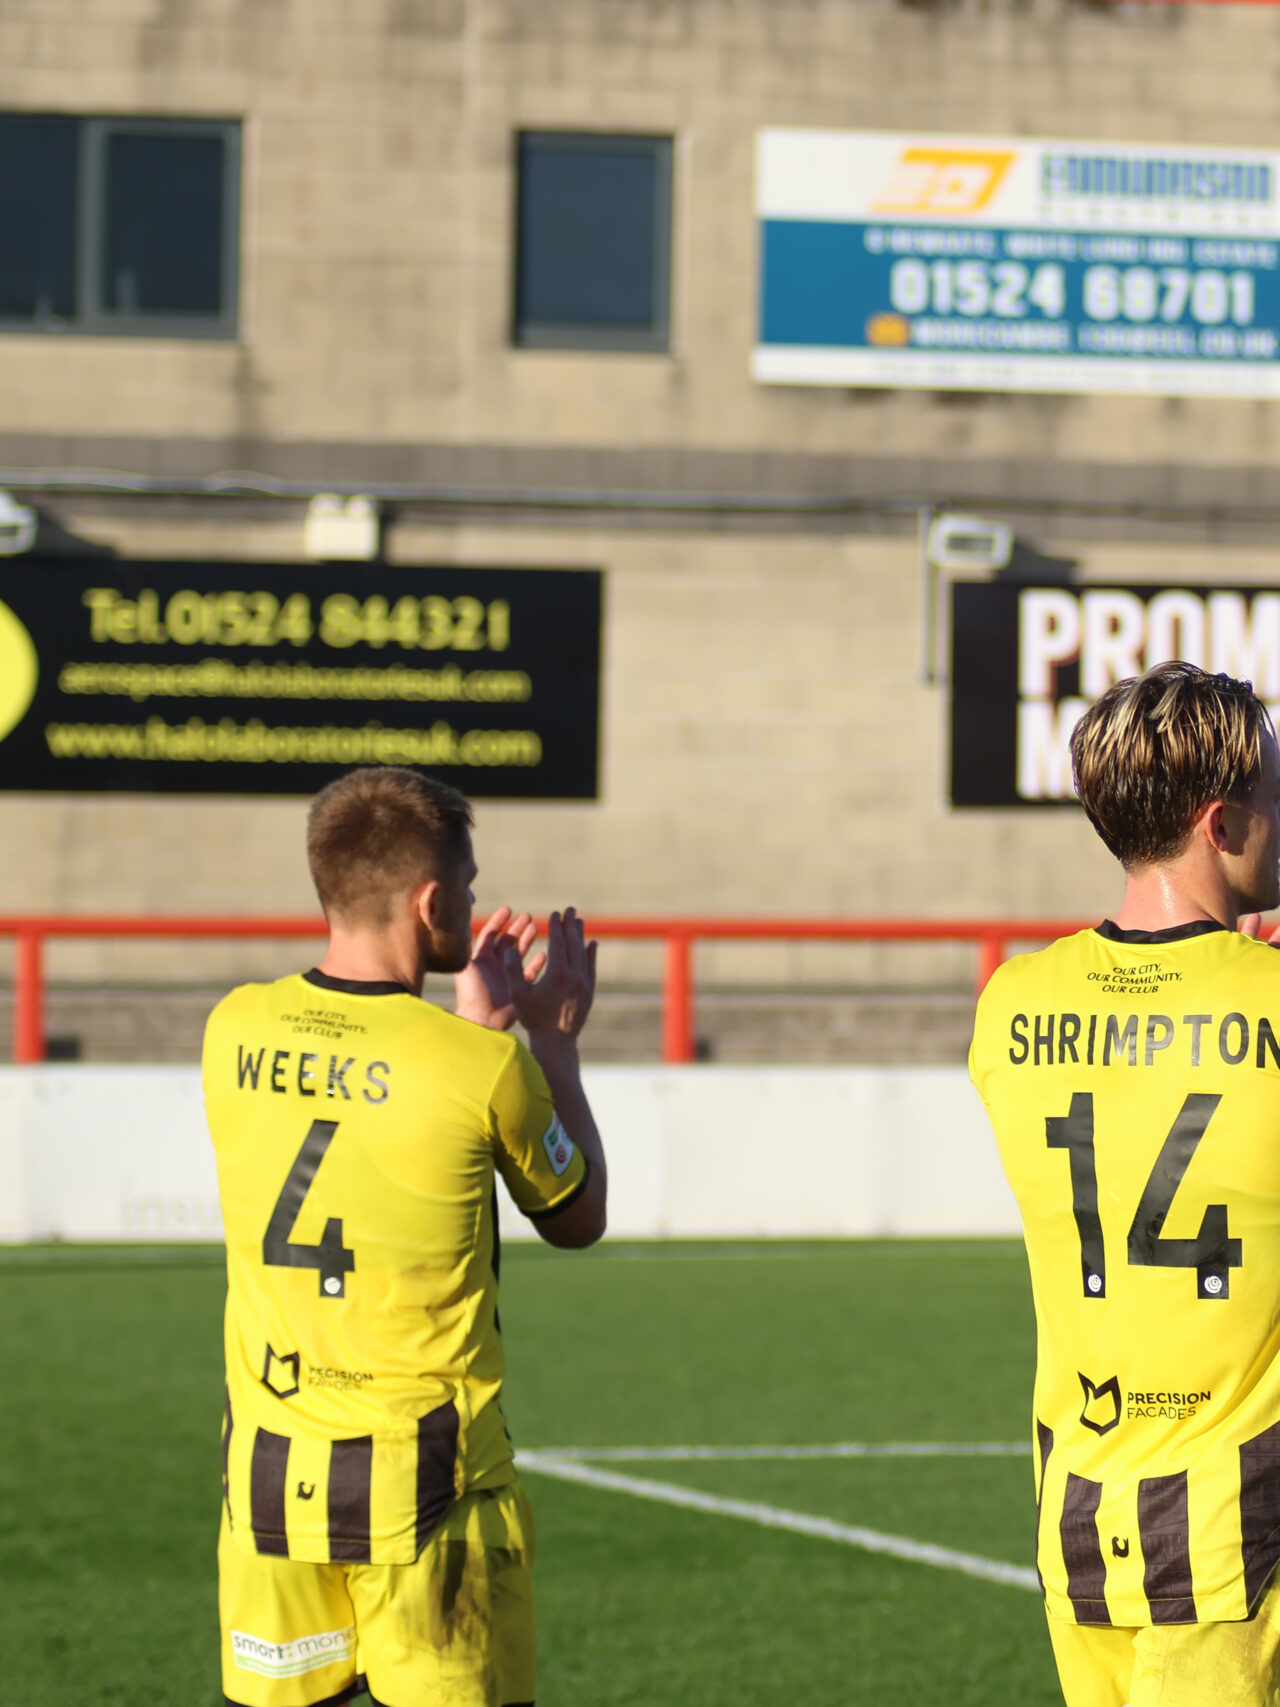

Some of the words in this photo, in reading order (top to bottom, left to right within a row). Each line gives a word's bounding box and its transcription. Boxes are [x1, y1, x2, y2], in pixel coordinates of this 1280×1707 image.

[890, 257, 1066, 319] 01524
[1082, 265, 1256, 326] 68701
[317, 592, 511, 652] 844321
[1086, 971, 1111, 982] OUR
[1102, 984, 1127, 993] OUR
[1128, 985, 1159, 994] CLUB
[1113, 967, 1137, 976] OUR
[236, 1044, 391, 1105] WEEKS
[262, 1118, 356, 1299] 4
[1045, 1092, 1243, 1300] 14
[1127, 1390, 1211, 1405] PRECISION
[1127, 1406, 1197, 1420] FACADES
